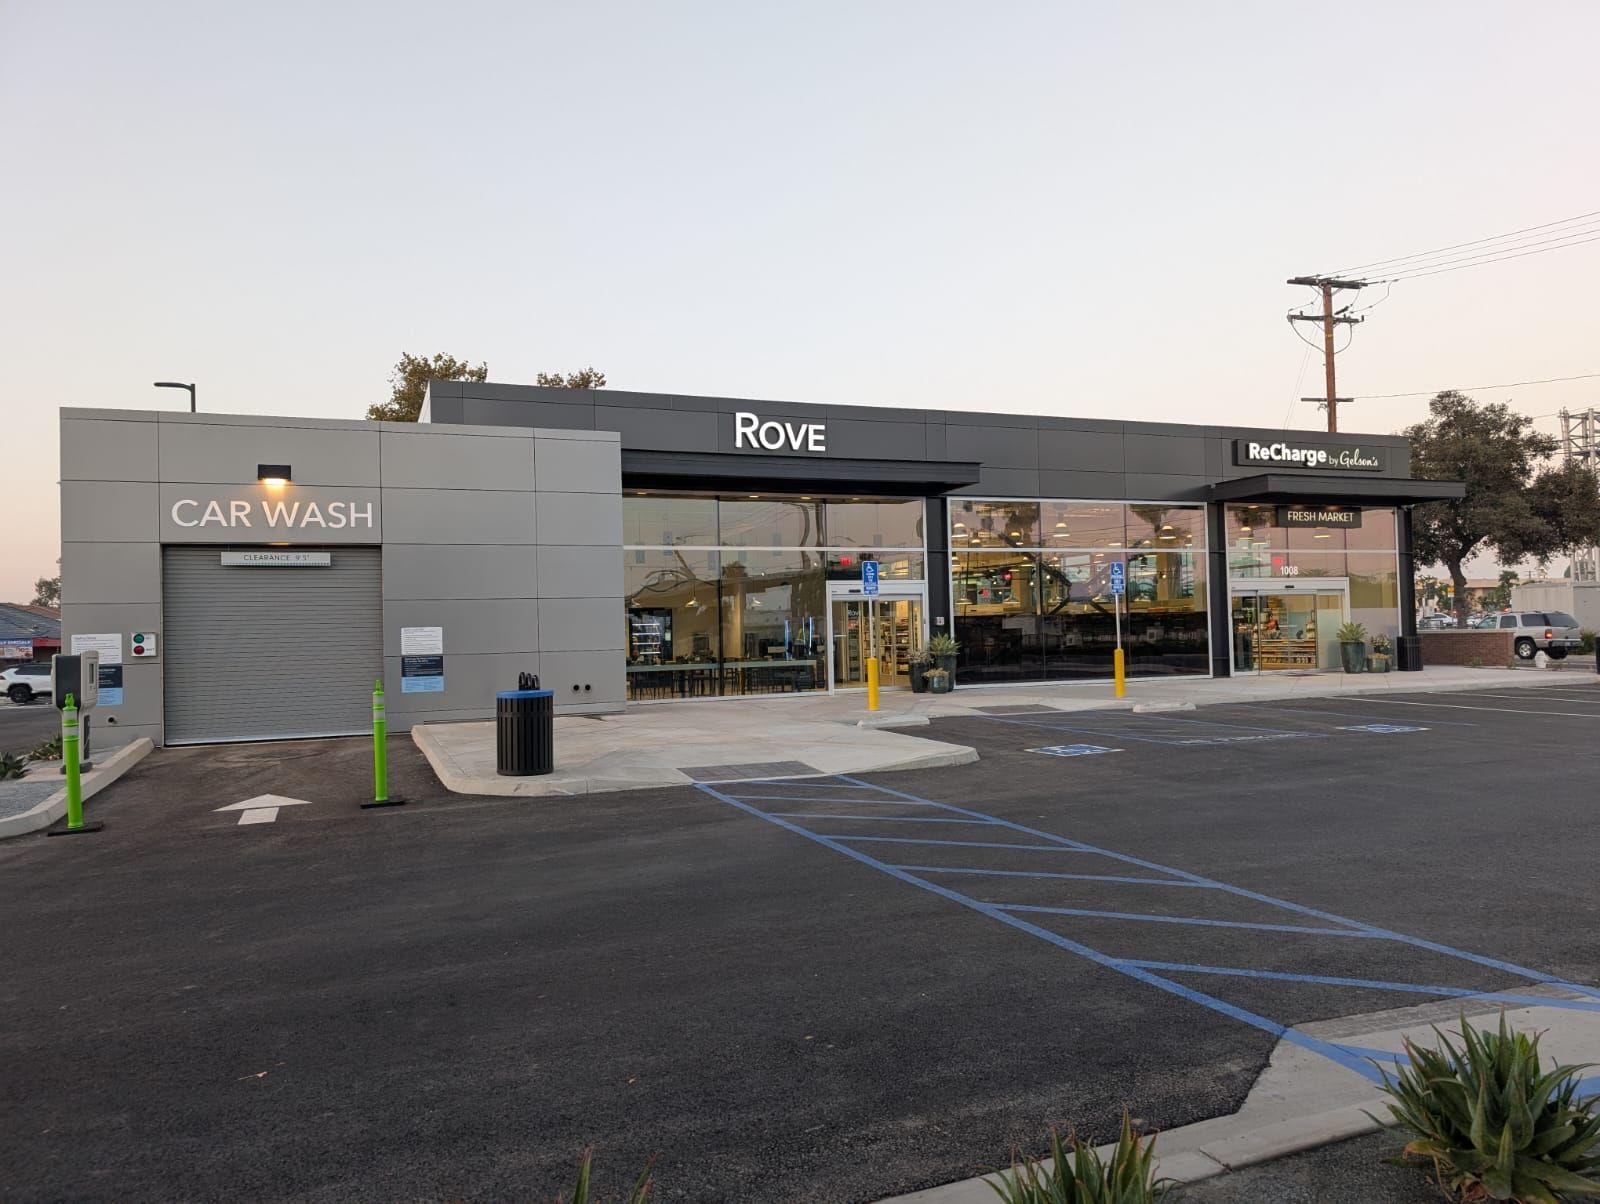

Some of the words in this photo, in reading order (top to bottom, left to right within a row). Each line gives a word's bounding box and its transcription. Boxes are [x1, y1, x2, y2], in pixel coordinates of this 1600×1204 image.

[1248, 442, 1327, 467] ReCharge
[1329, 455, 1339, 467] by
[1340, 448, 1379, 468] Gelson's
[171, 499, 252, 528] CAR
[261, 500, 373, 529] WASH
[1287, 511, 1316, 522] FRESH
[1318, 511, 1355, 523] MARKET
[1280, 566, 1299, 575] 1008
